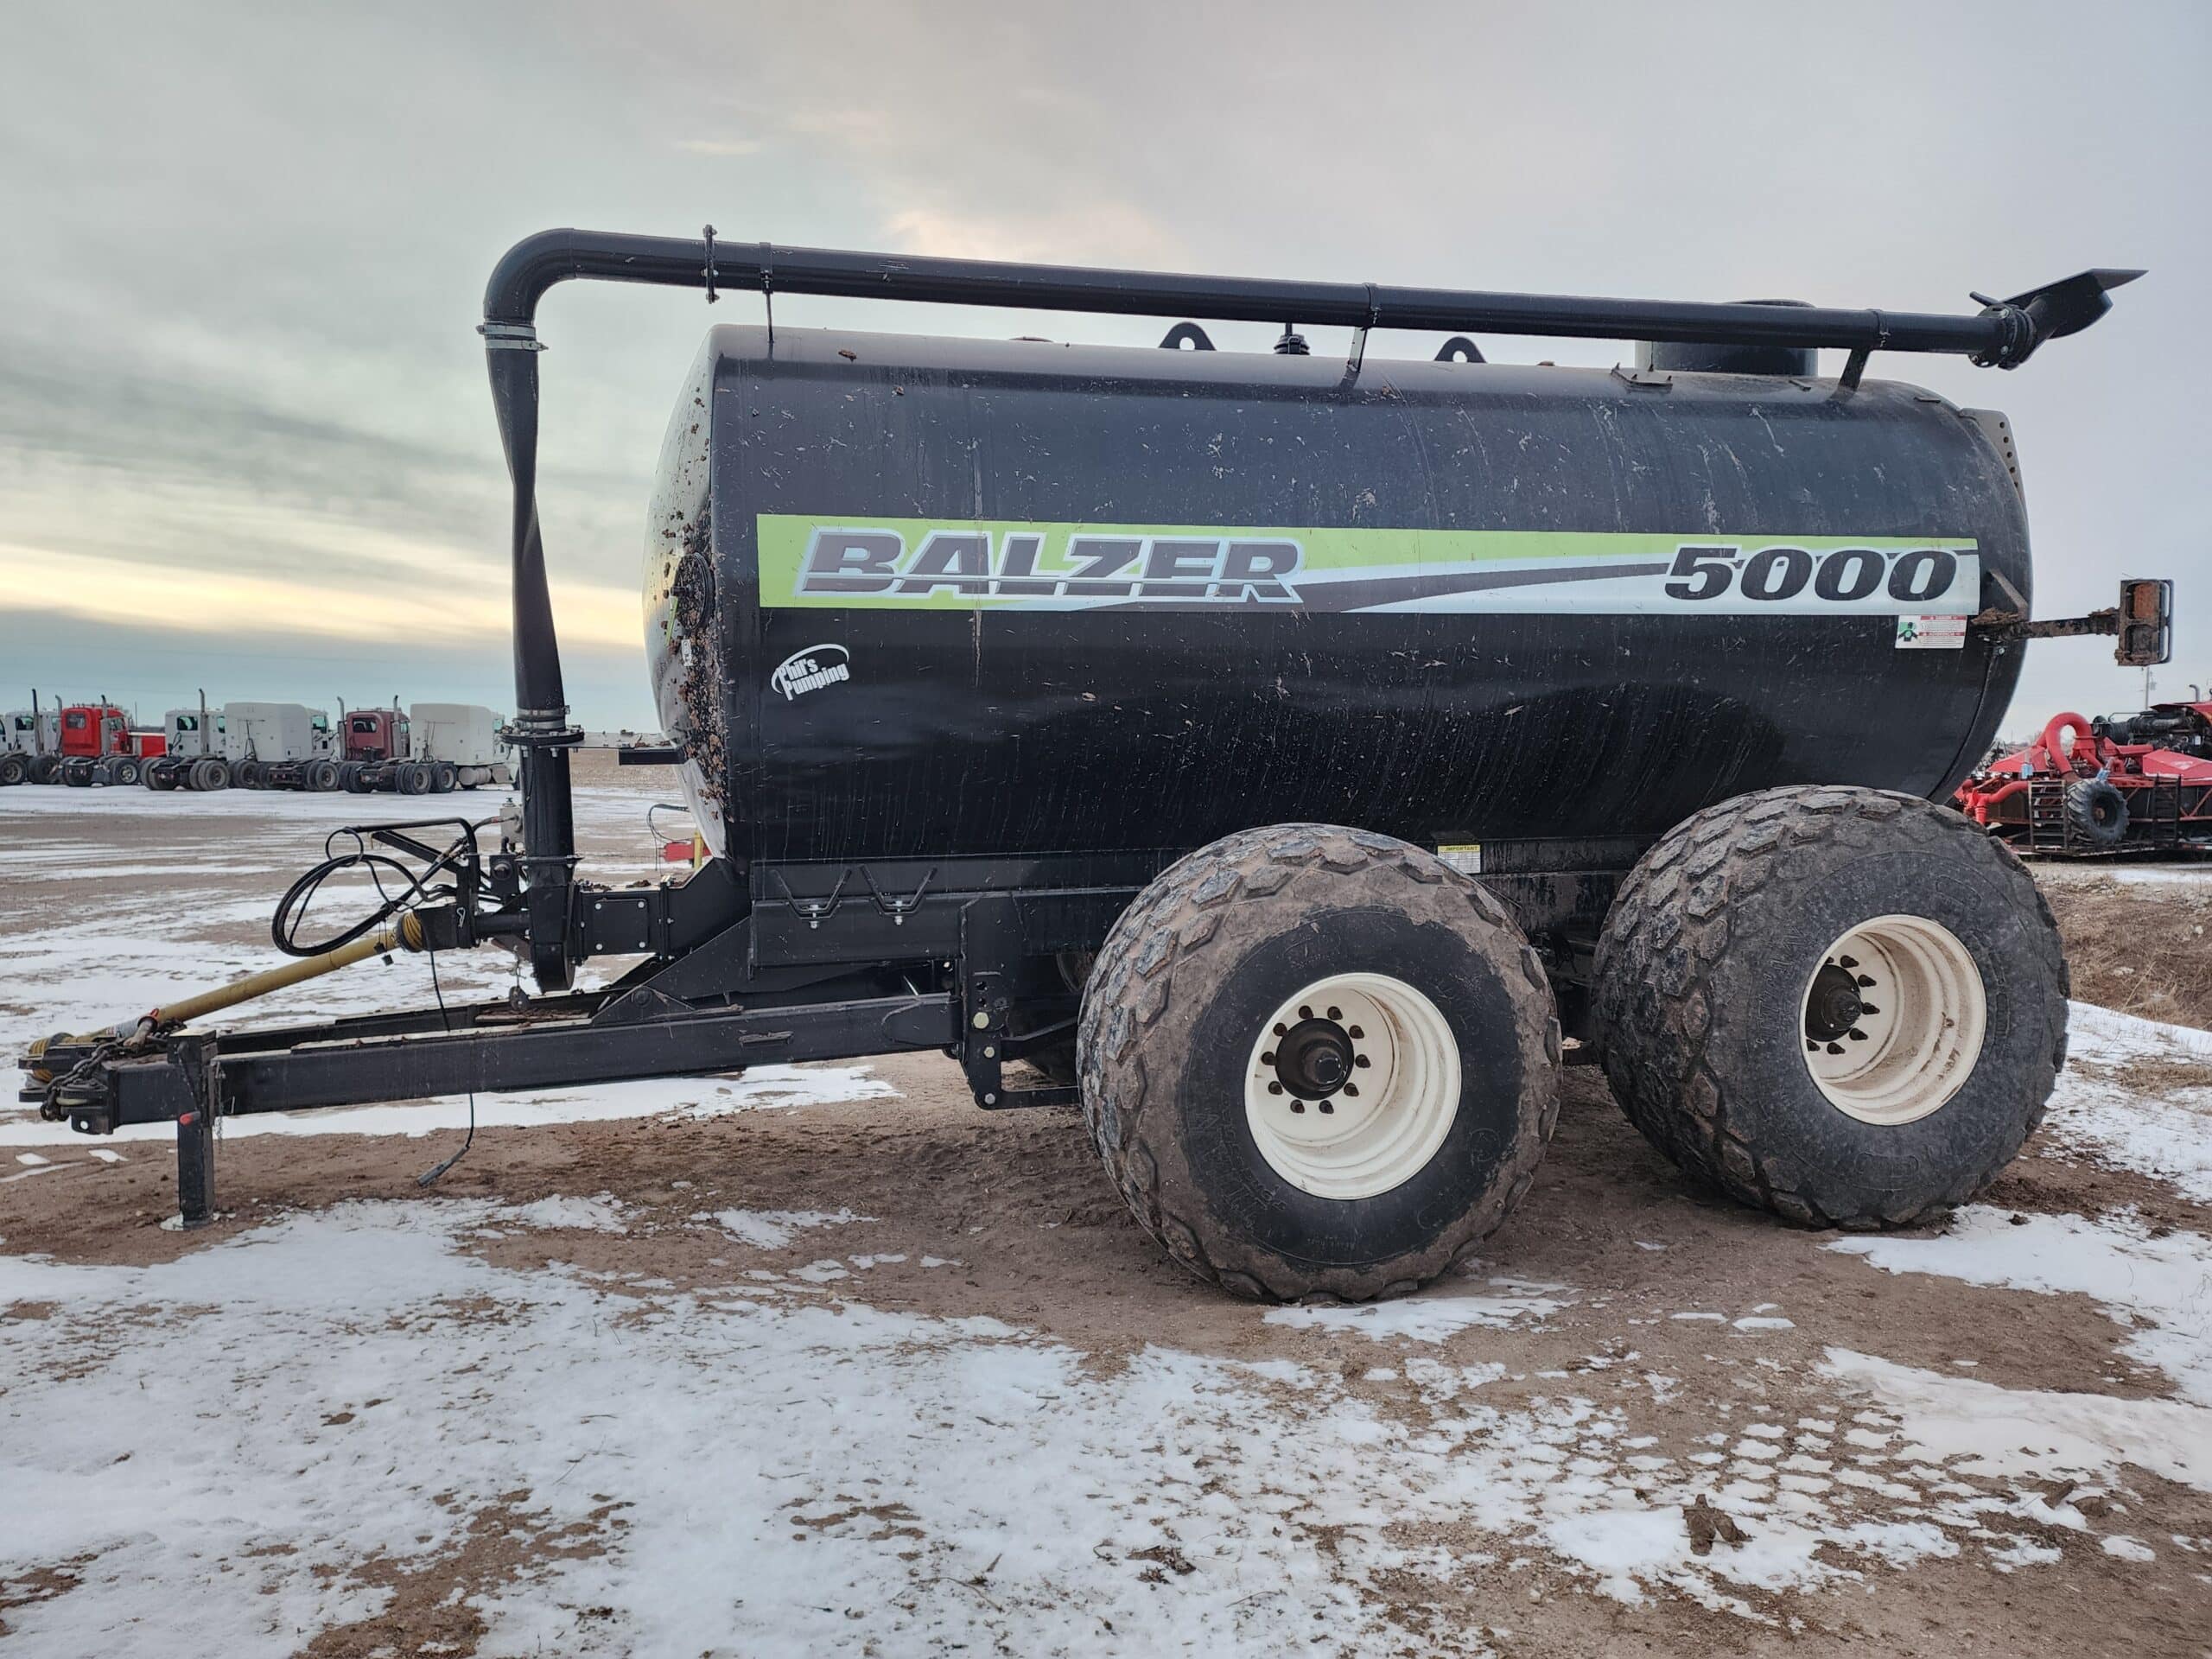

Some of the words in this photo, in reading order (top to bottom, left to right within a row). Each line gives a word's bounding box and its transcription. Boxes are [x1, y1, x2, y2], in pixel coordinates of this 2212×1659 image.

[796, 528, 1305, 603] BALZER
[1665, 547, 1957, 601] 5000
[776, 658, 818, 680] Phil's
[783, 664, 849, 700] Pumping
